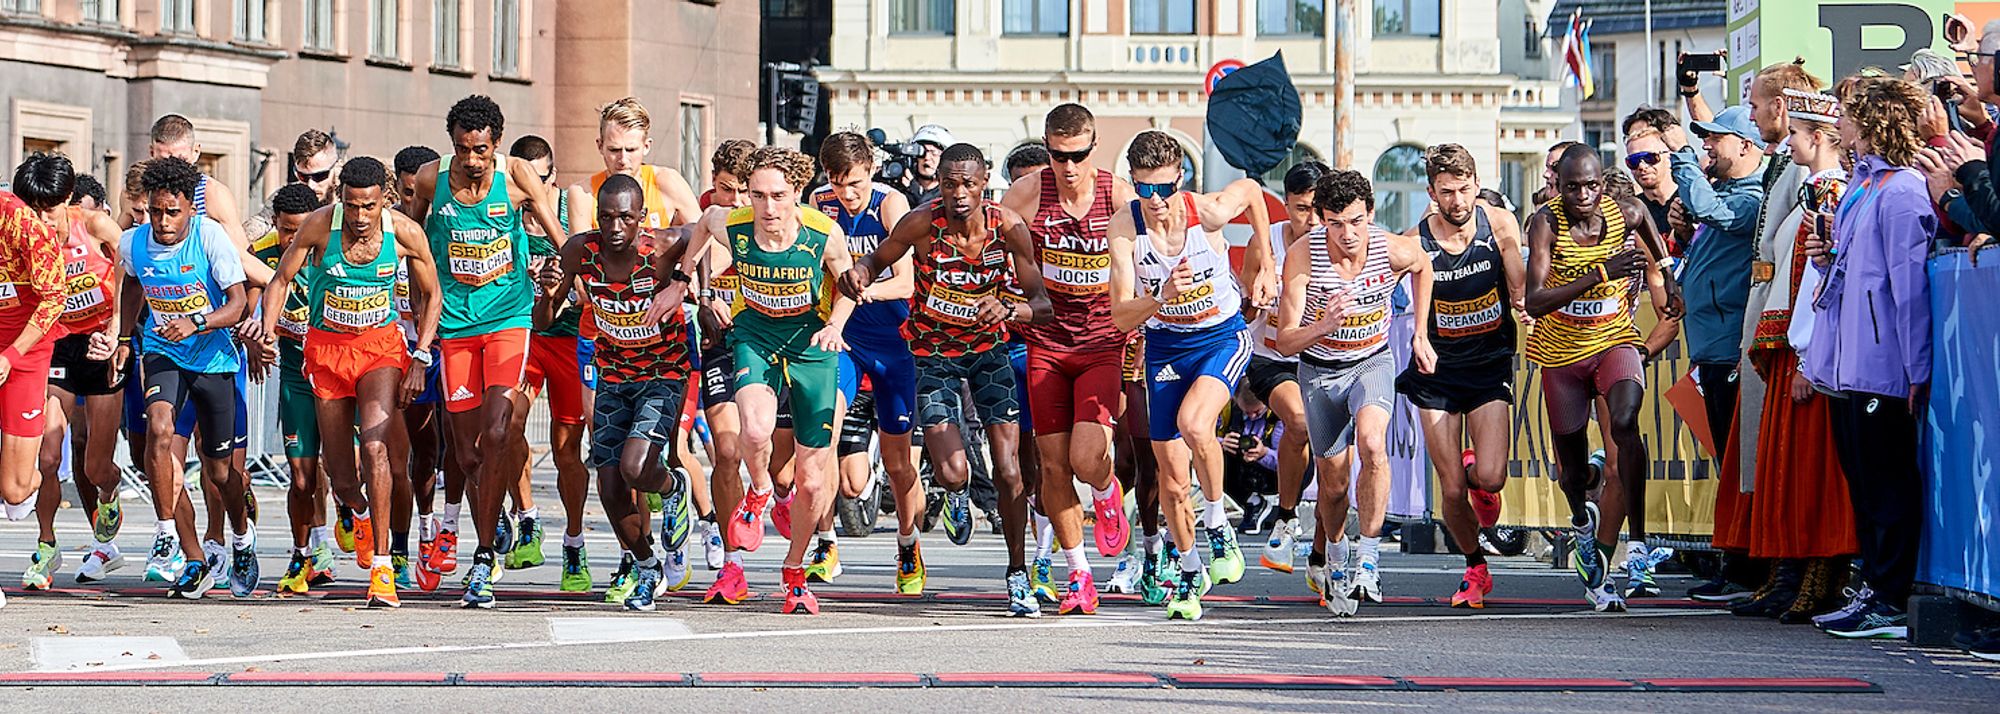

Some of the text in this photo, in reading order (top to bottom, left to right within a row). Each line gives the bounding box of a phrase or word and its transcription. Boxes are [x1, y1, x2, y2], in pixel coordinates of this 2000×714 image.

[452, 229, 498, 242] ETHIOPIA
[1044, 234, 1109, 252] LATVIA
[450, 238, 509, 259] SEIKO
[454, 252, 510, 275] KEJELCHA
[1044, 251, 1110, 269] SEIKO
[736, 261, 814, 280] SOUTH AFRICA
[1055, 269, 1100, 284] JOCIS
[1433, 260, 1491, 282] NEW ZEALAND
[143, 281, 204, 296] ERITREA
[742, 276, 808, 297] SEIKO
[150, 295, 207, 312] SEIKO
[326, 293, 387, 312] SEIKO
[590, 293, 653, 314] KENYA
[745, 289, 808, 308] CHAUMETON
[932, 298, 980, 318] KEMB
[1437, 293, 1498, 315] SEIKO
[326, 307, 387, 326] GEBRHIWET
[1440, 305, 1501, 328] SPEAKMAN
[1329, 322, 1381, 340] ANAGAN
